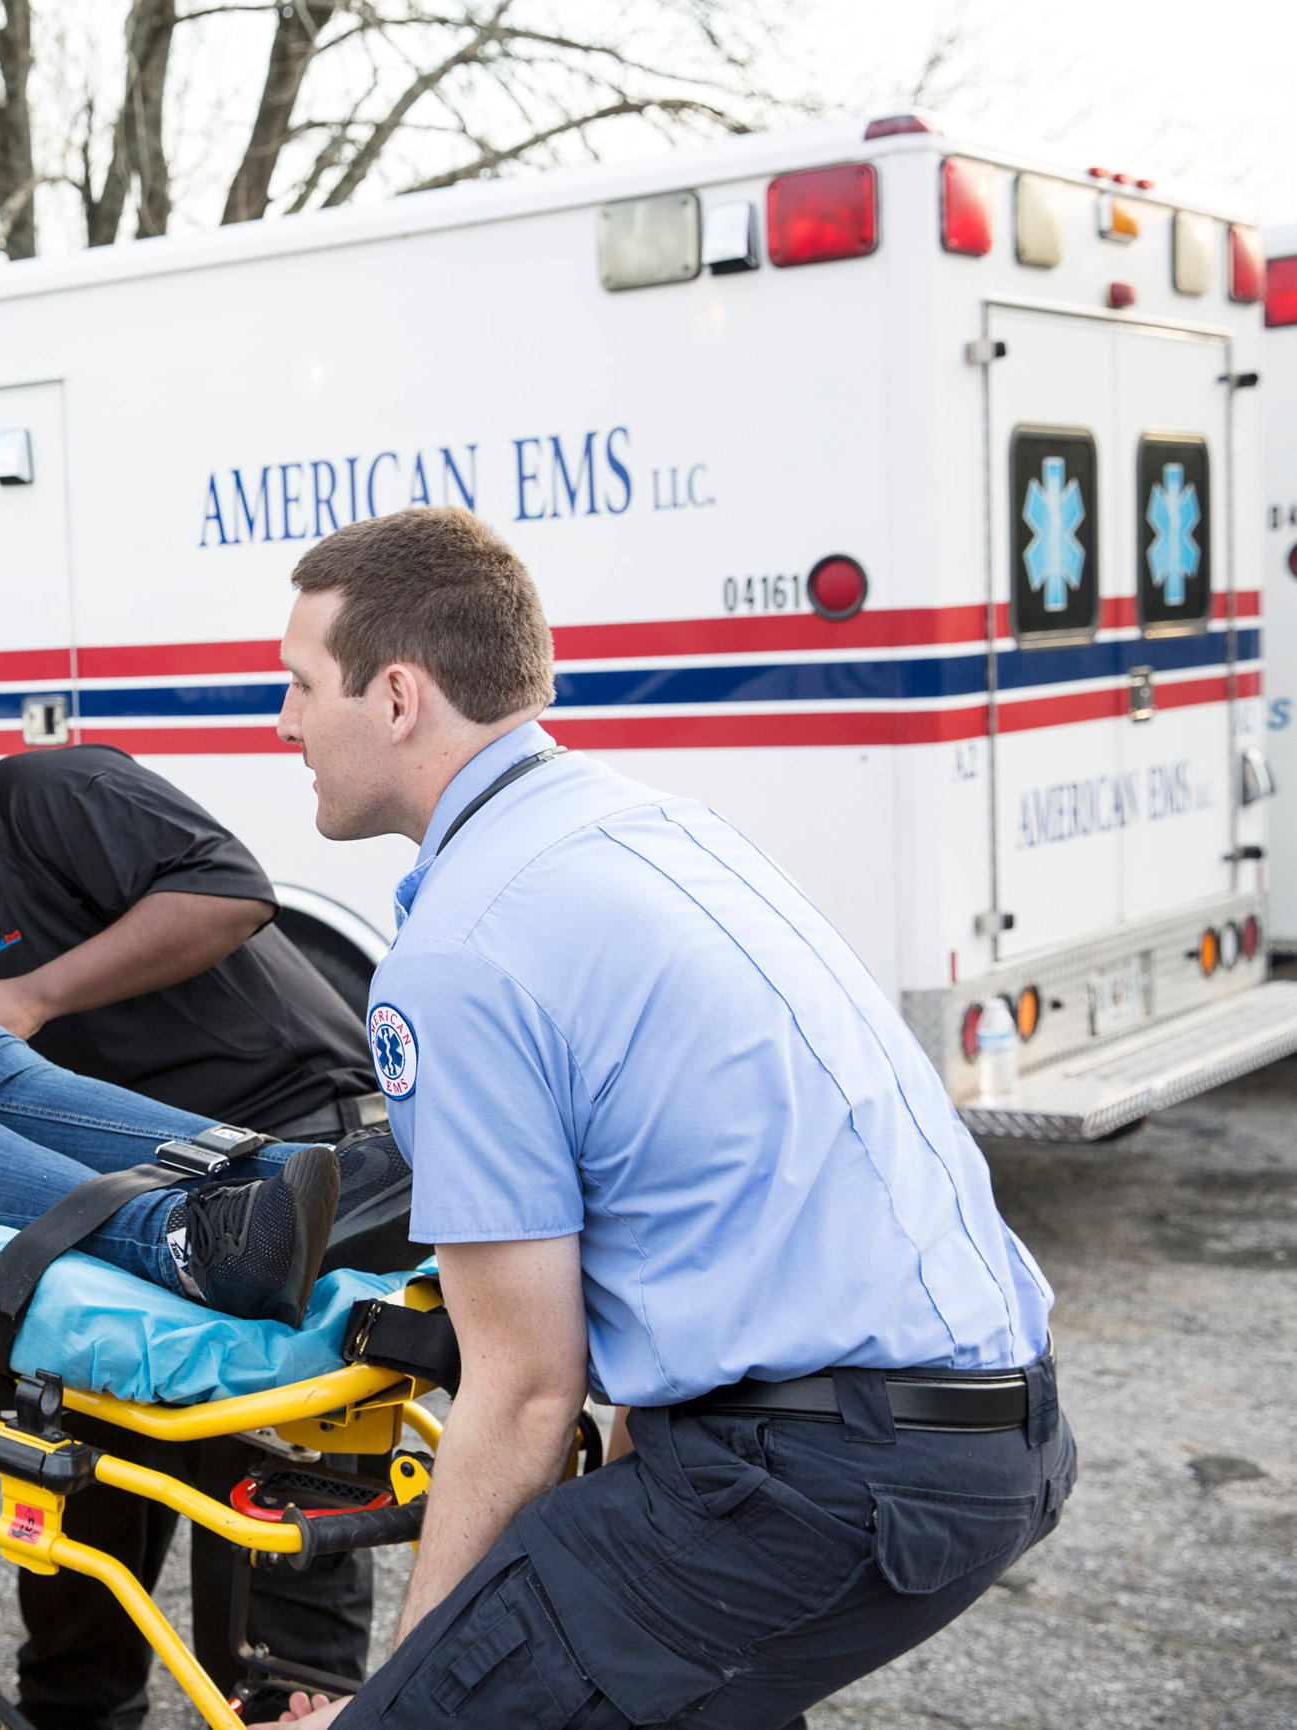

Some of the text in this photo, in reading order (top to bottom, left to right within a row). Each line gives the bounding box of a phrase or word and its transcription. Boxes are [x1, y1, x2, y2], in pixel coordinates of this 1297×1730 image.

[198, 443, 480, 548] AMERICAN
[511, 425, 633, 522] EMS
[723, 574, 801, 613] 04161
[1015, 769, 1140, 851] AMERICAN
[1146, 759, 1191, 821] EMS
[386, 1077, 409, 1094] EMS
